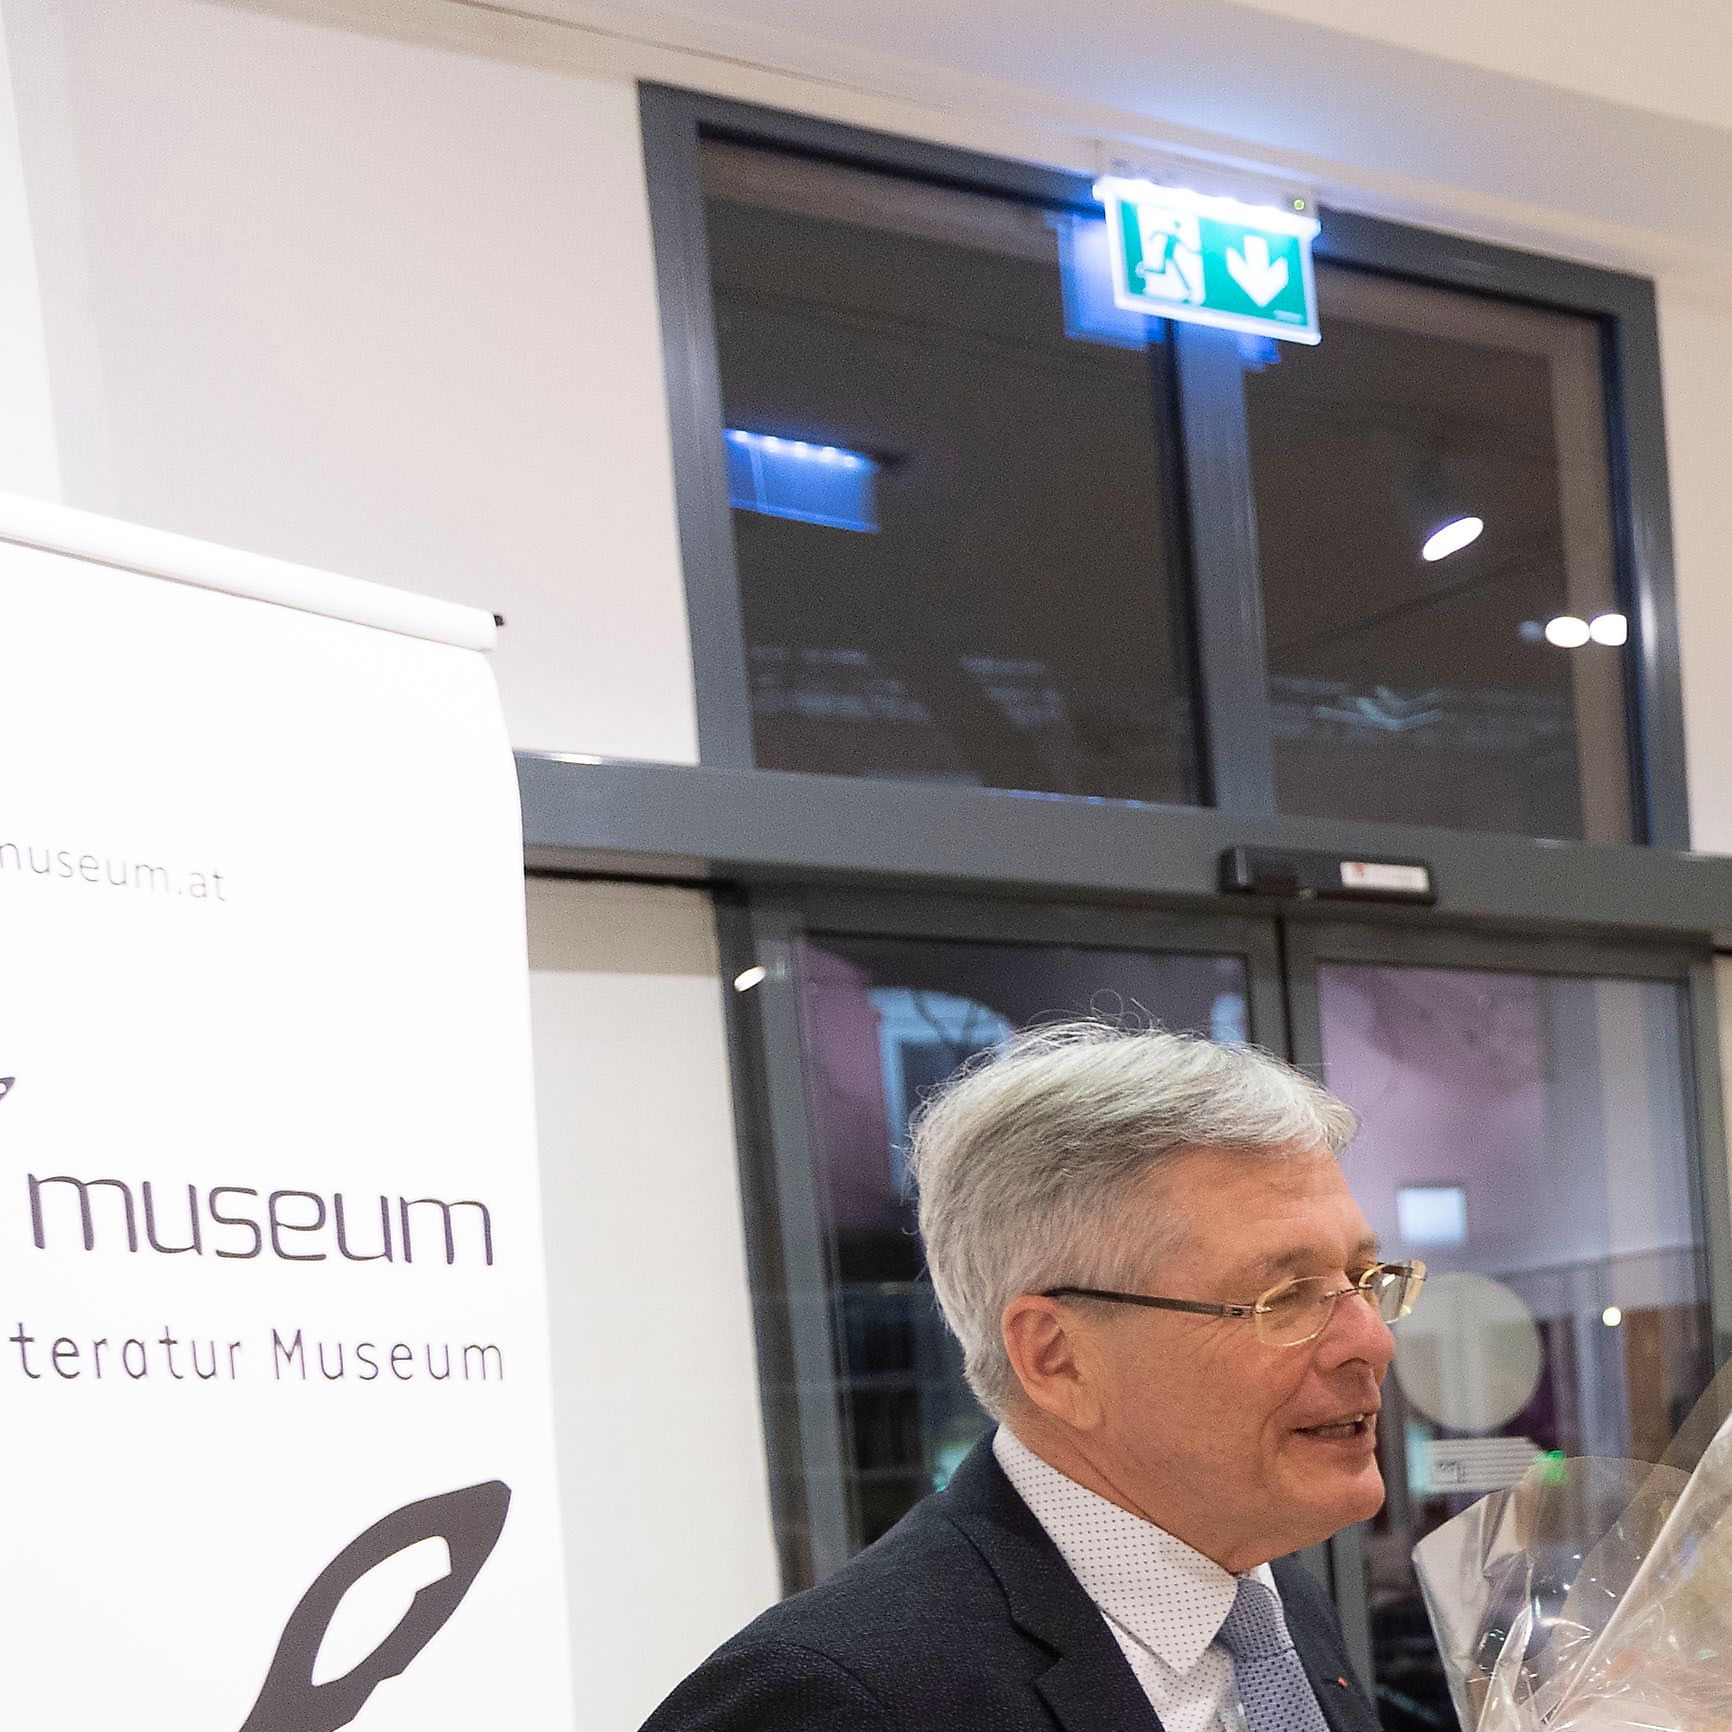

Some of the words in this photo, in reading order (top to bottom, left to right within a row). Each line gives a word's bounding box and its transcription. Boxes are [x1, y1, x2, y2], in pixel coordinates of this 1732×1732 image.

[27, 1172, 494, 1267] museum
[8, 1322, 242, 1381] teratur
[272, 1327, 505, 1382] Museum
